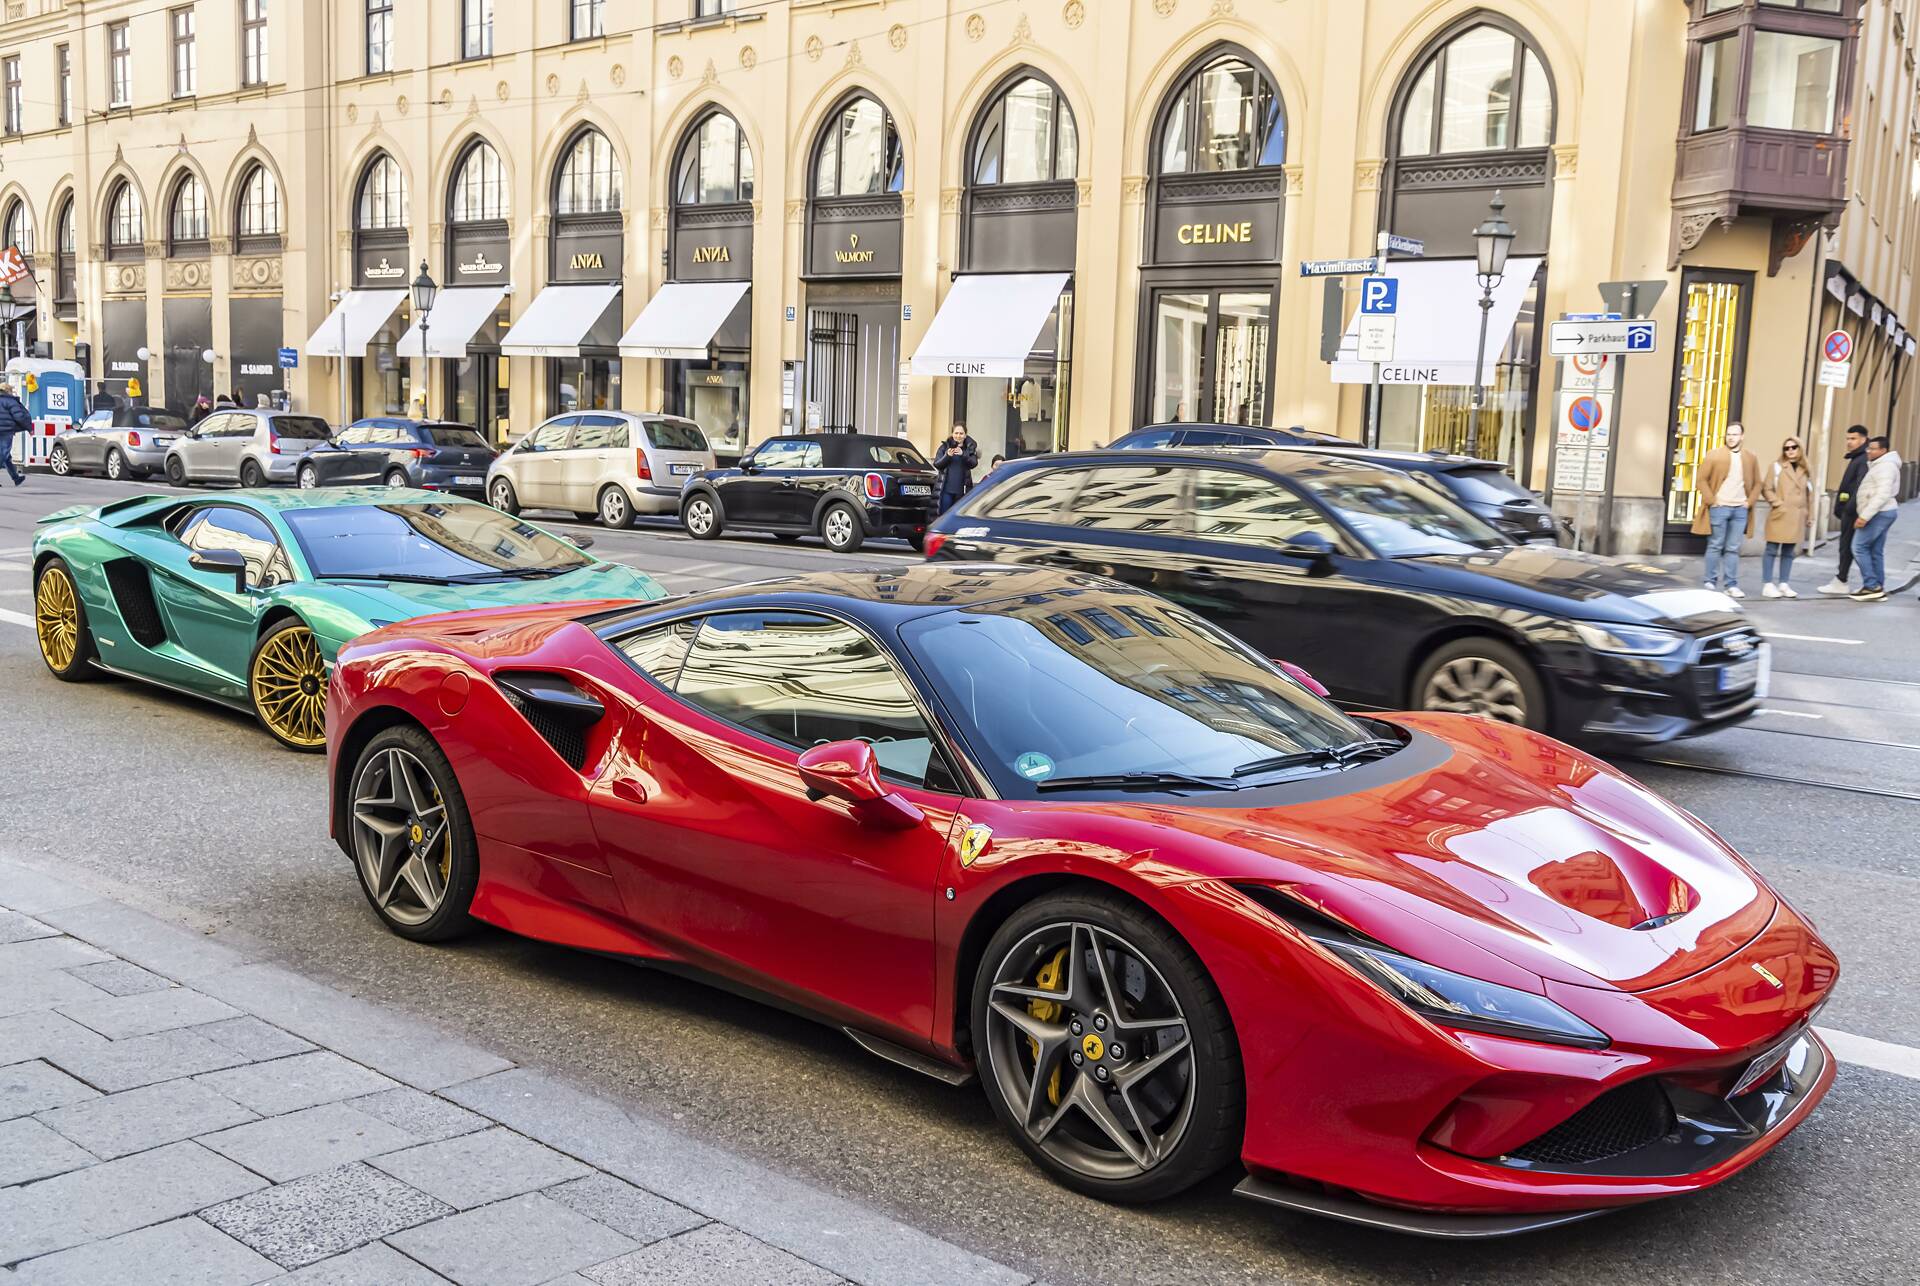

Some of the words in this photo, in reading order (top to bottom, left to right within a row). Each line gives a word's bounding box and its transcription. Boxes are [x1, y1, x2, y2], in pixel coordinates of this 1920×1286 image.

[1178, 222, 1252, 244] CELINE
[835, 250, 874, 262] VALMONT
[1305, 261, 1373, 274] Maximilianstr.
[1366, 281, 1388, 310] P
[1588, 334, 1626, 343] Parkhaus
[947, 363, 986, 374] CELINE
[1382, 368, 1439, 381] CELINE
